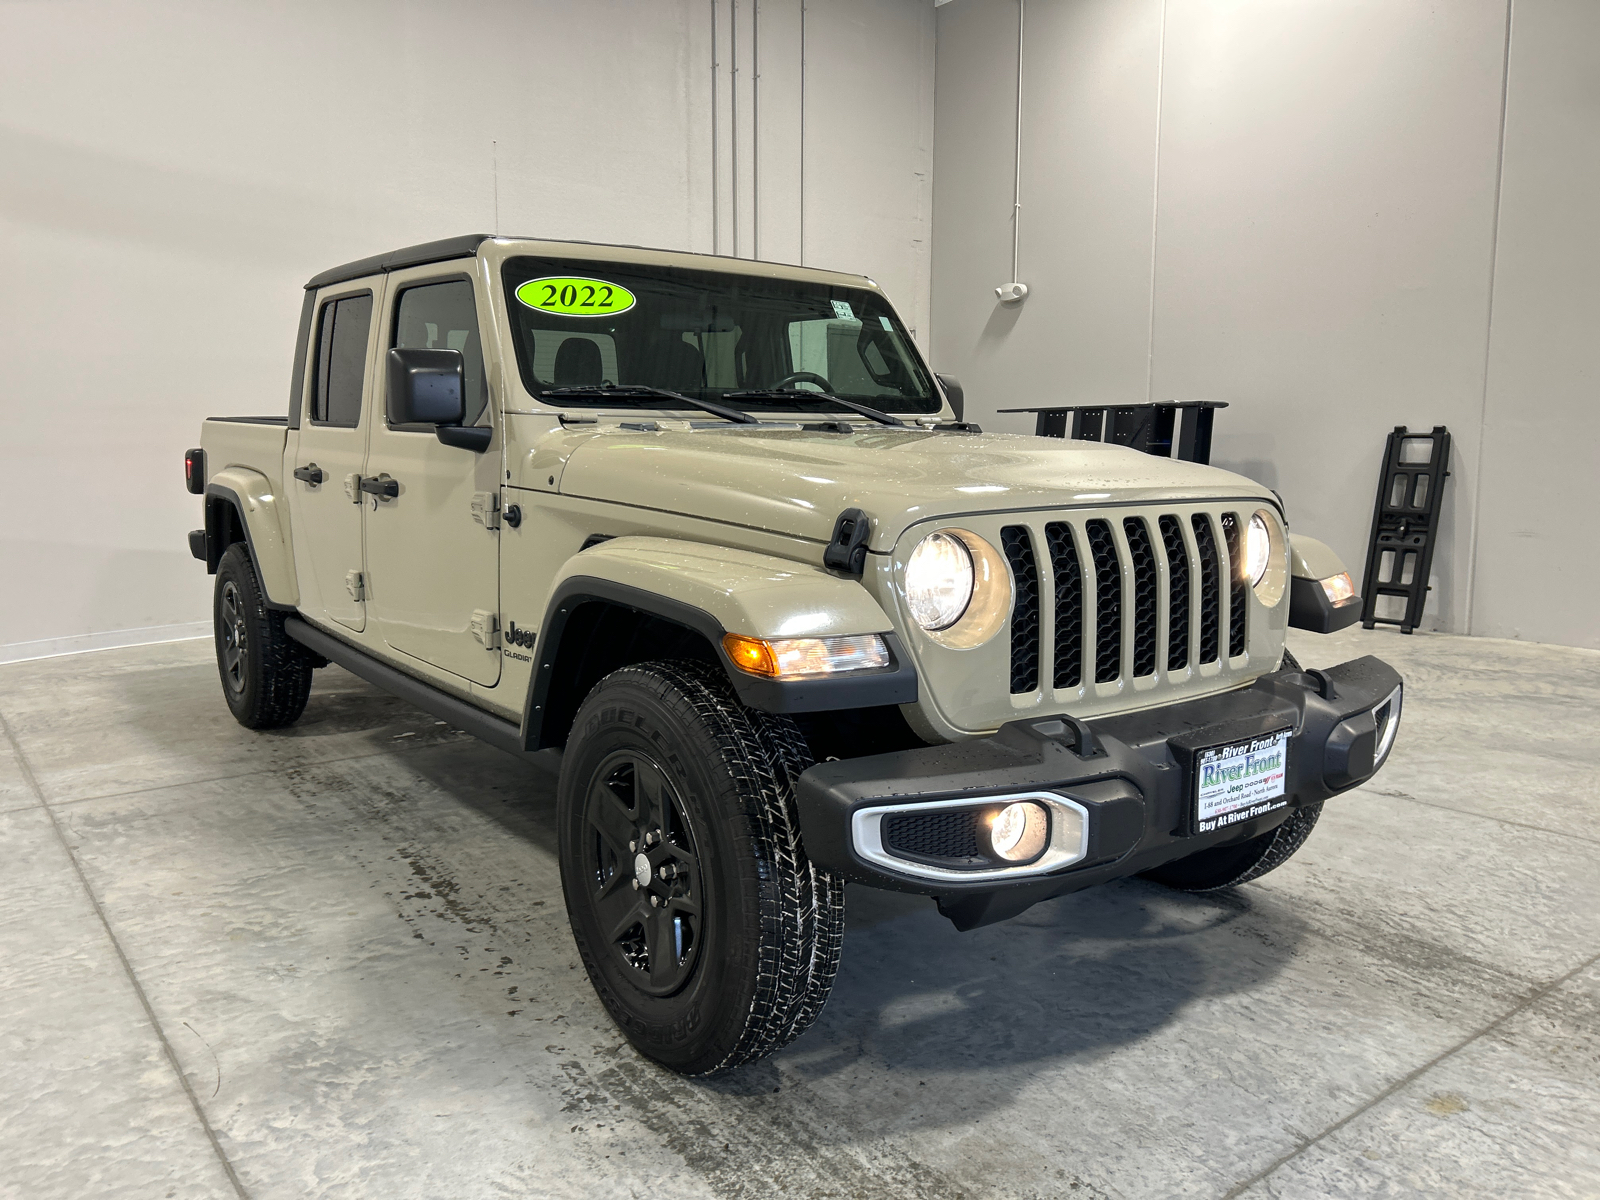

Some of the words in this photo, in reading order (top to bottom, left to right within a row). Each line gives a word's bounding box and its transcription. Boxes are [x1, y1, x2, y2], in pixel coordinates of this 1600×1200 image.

[540, 285, 614, 307] 2022
[1222, 745, 1248, 760] River
[1251, 736, 1273, 751] Front
[1214, 798, 1222, 806] and
[1223, 794, 1240, 804] Orchard
[1241, 791, 1252, 800] Road
[1227, 783, 1243, 794] Jeep
[1200, 820, 1216, 832] Buy
[1217, 817, 1227, 827] At
[1228, 810, 1249, 823] River
[1250, 801, 1287, 817] Front.com
